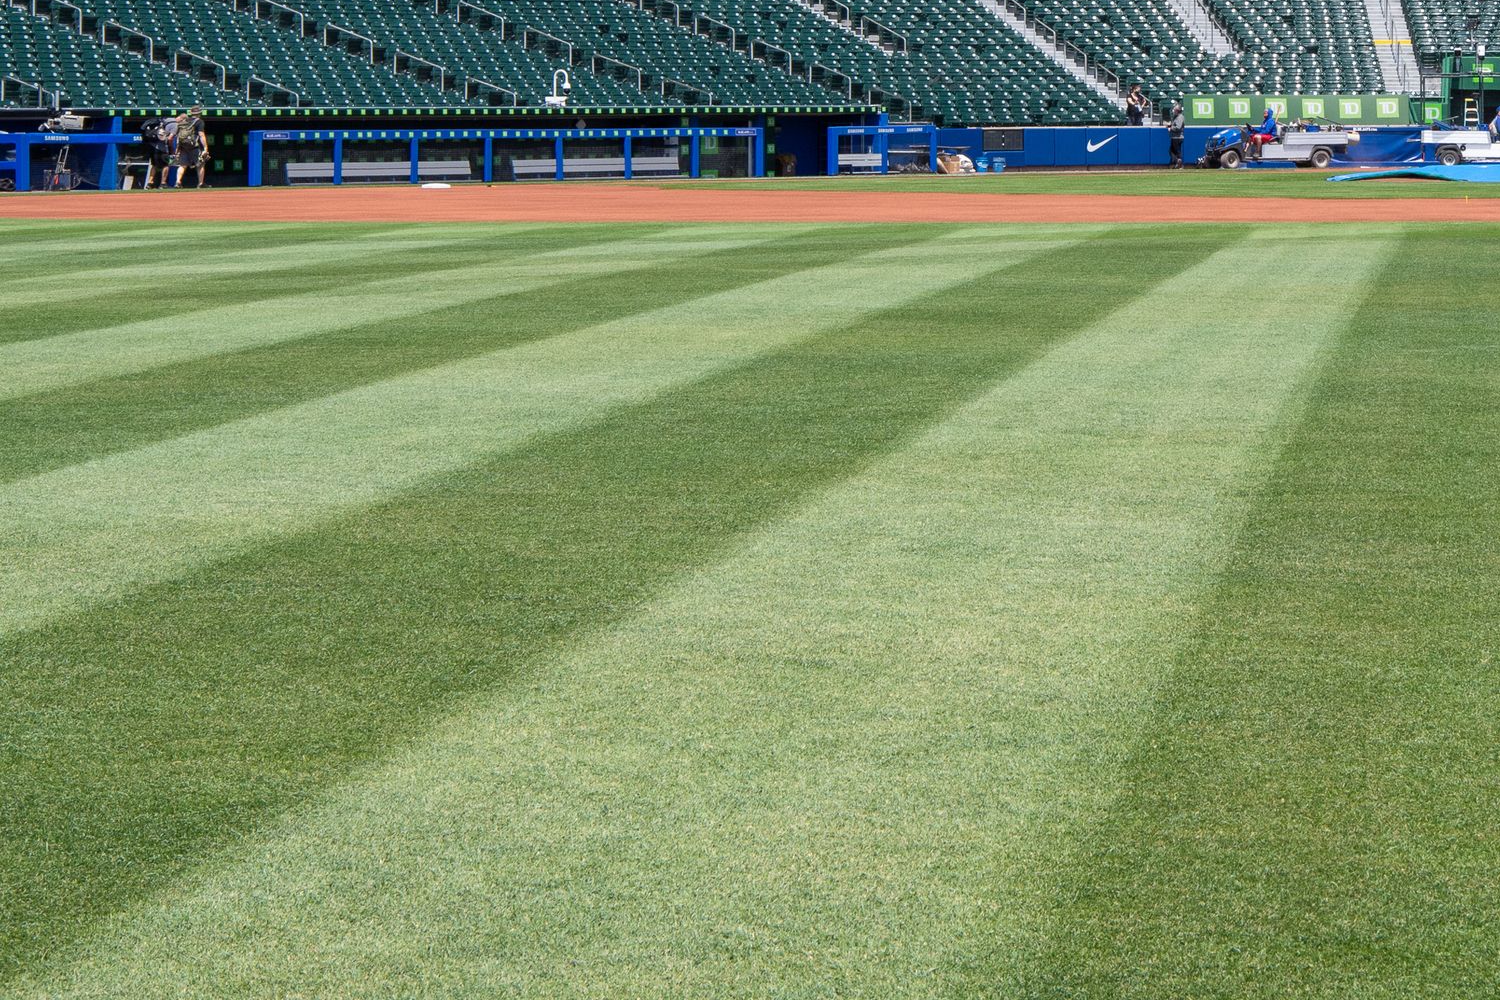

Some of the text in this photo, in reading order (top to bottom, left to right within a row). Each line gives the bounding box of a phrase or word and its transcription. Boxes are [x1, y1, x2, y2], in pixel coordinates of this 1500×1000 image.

[1195, 101, 1397, 115] TD TD TD TD TD TD
